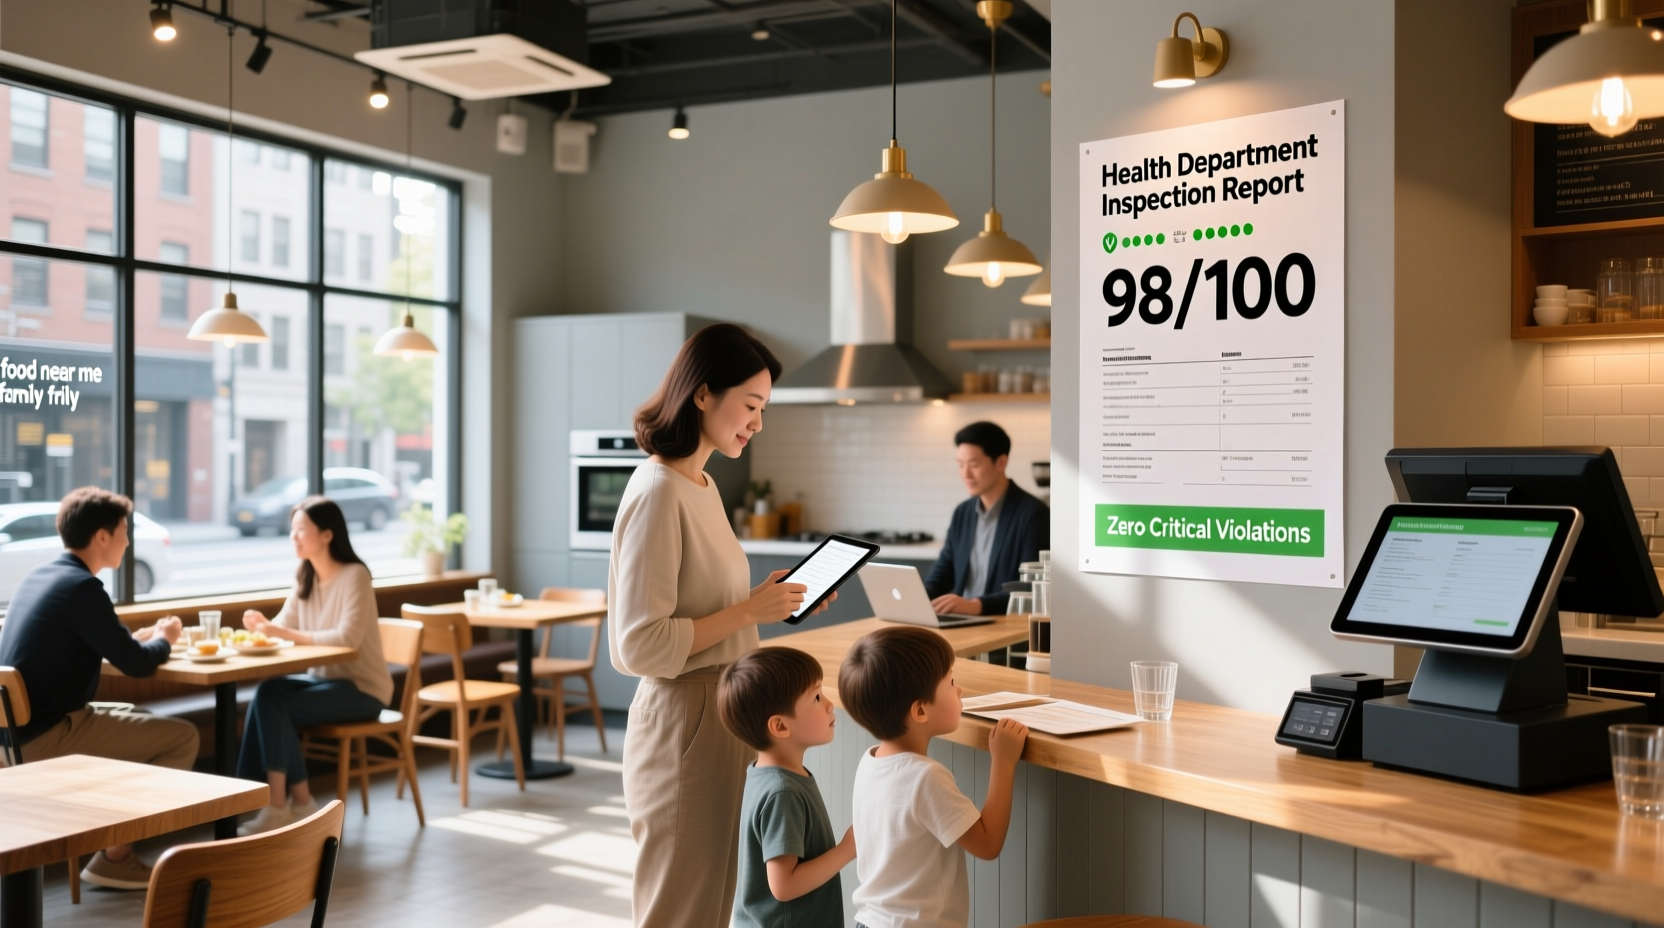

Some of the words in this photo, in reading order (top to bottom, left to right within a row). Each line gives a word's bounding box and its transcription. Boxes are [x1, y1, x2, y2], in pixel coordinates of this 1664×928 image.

[1102, 155, 1172, 187] Health
[1177, 133, 1319, 178] Department
[1102, 181, 1216, 219] Inspection
[1222, 168, 1305, 204] Report
[1102, 252, 1316, 330] 98/100
[0, 356, 37, 381] food
[40, 364, 76, 382] near
[78, 366, 103, 383] me
[1106, 515, 1146, 537] Zero
[1149, 516, 1211, 540] Critical
[1215, 518, 1311, 544] Violations
